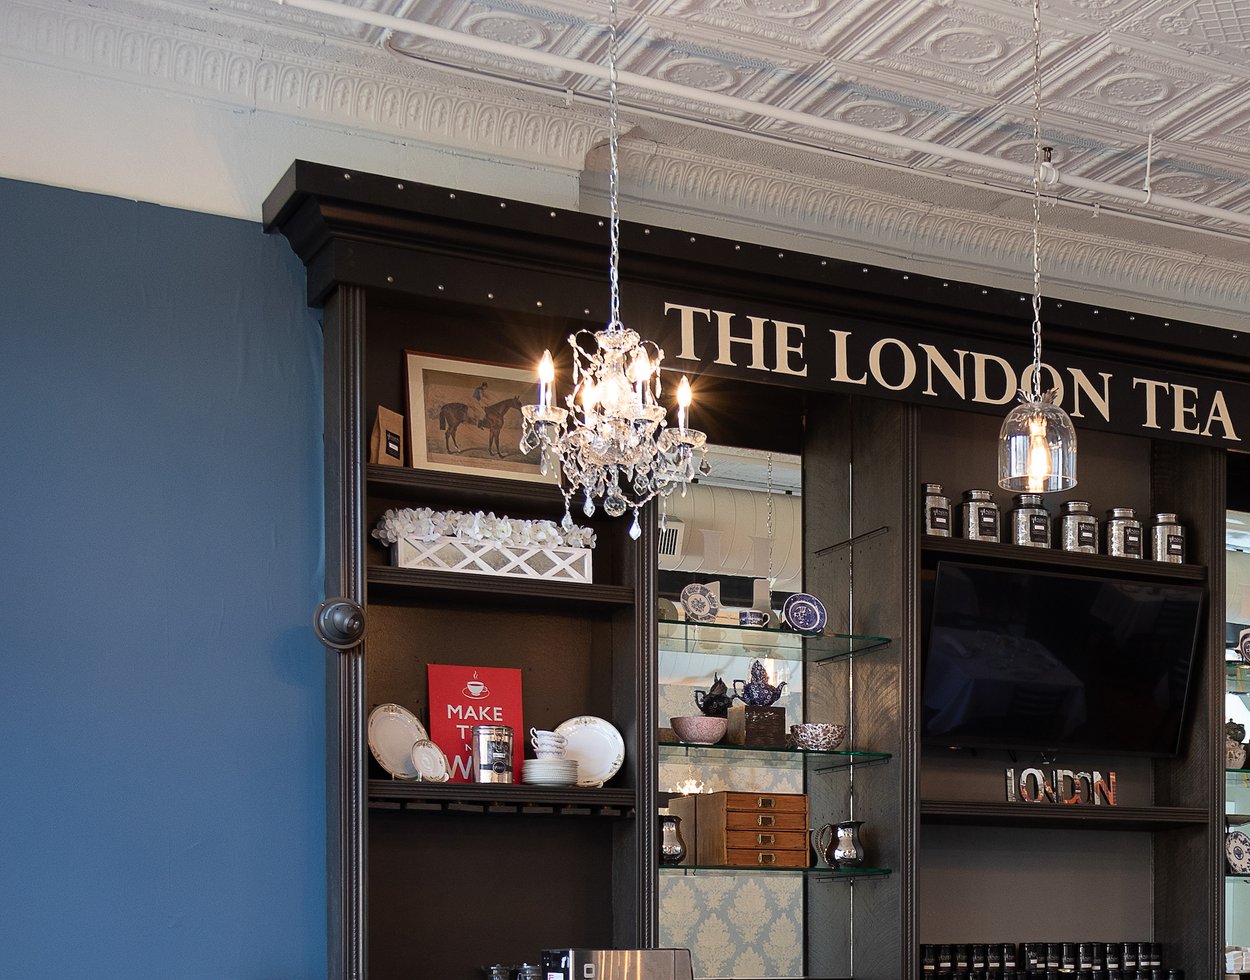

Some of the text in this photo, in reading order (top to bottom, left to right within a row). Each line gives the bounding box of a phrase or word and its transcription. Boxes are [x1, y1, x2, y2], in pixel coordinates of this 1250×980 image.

[664, 301, 808, 378] THE
[829, 329, 1113, 423] LONDON
[1133, 377, 1242, 442] TEA
[447, 704, 504, 722] MAKE
